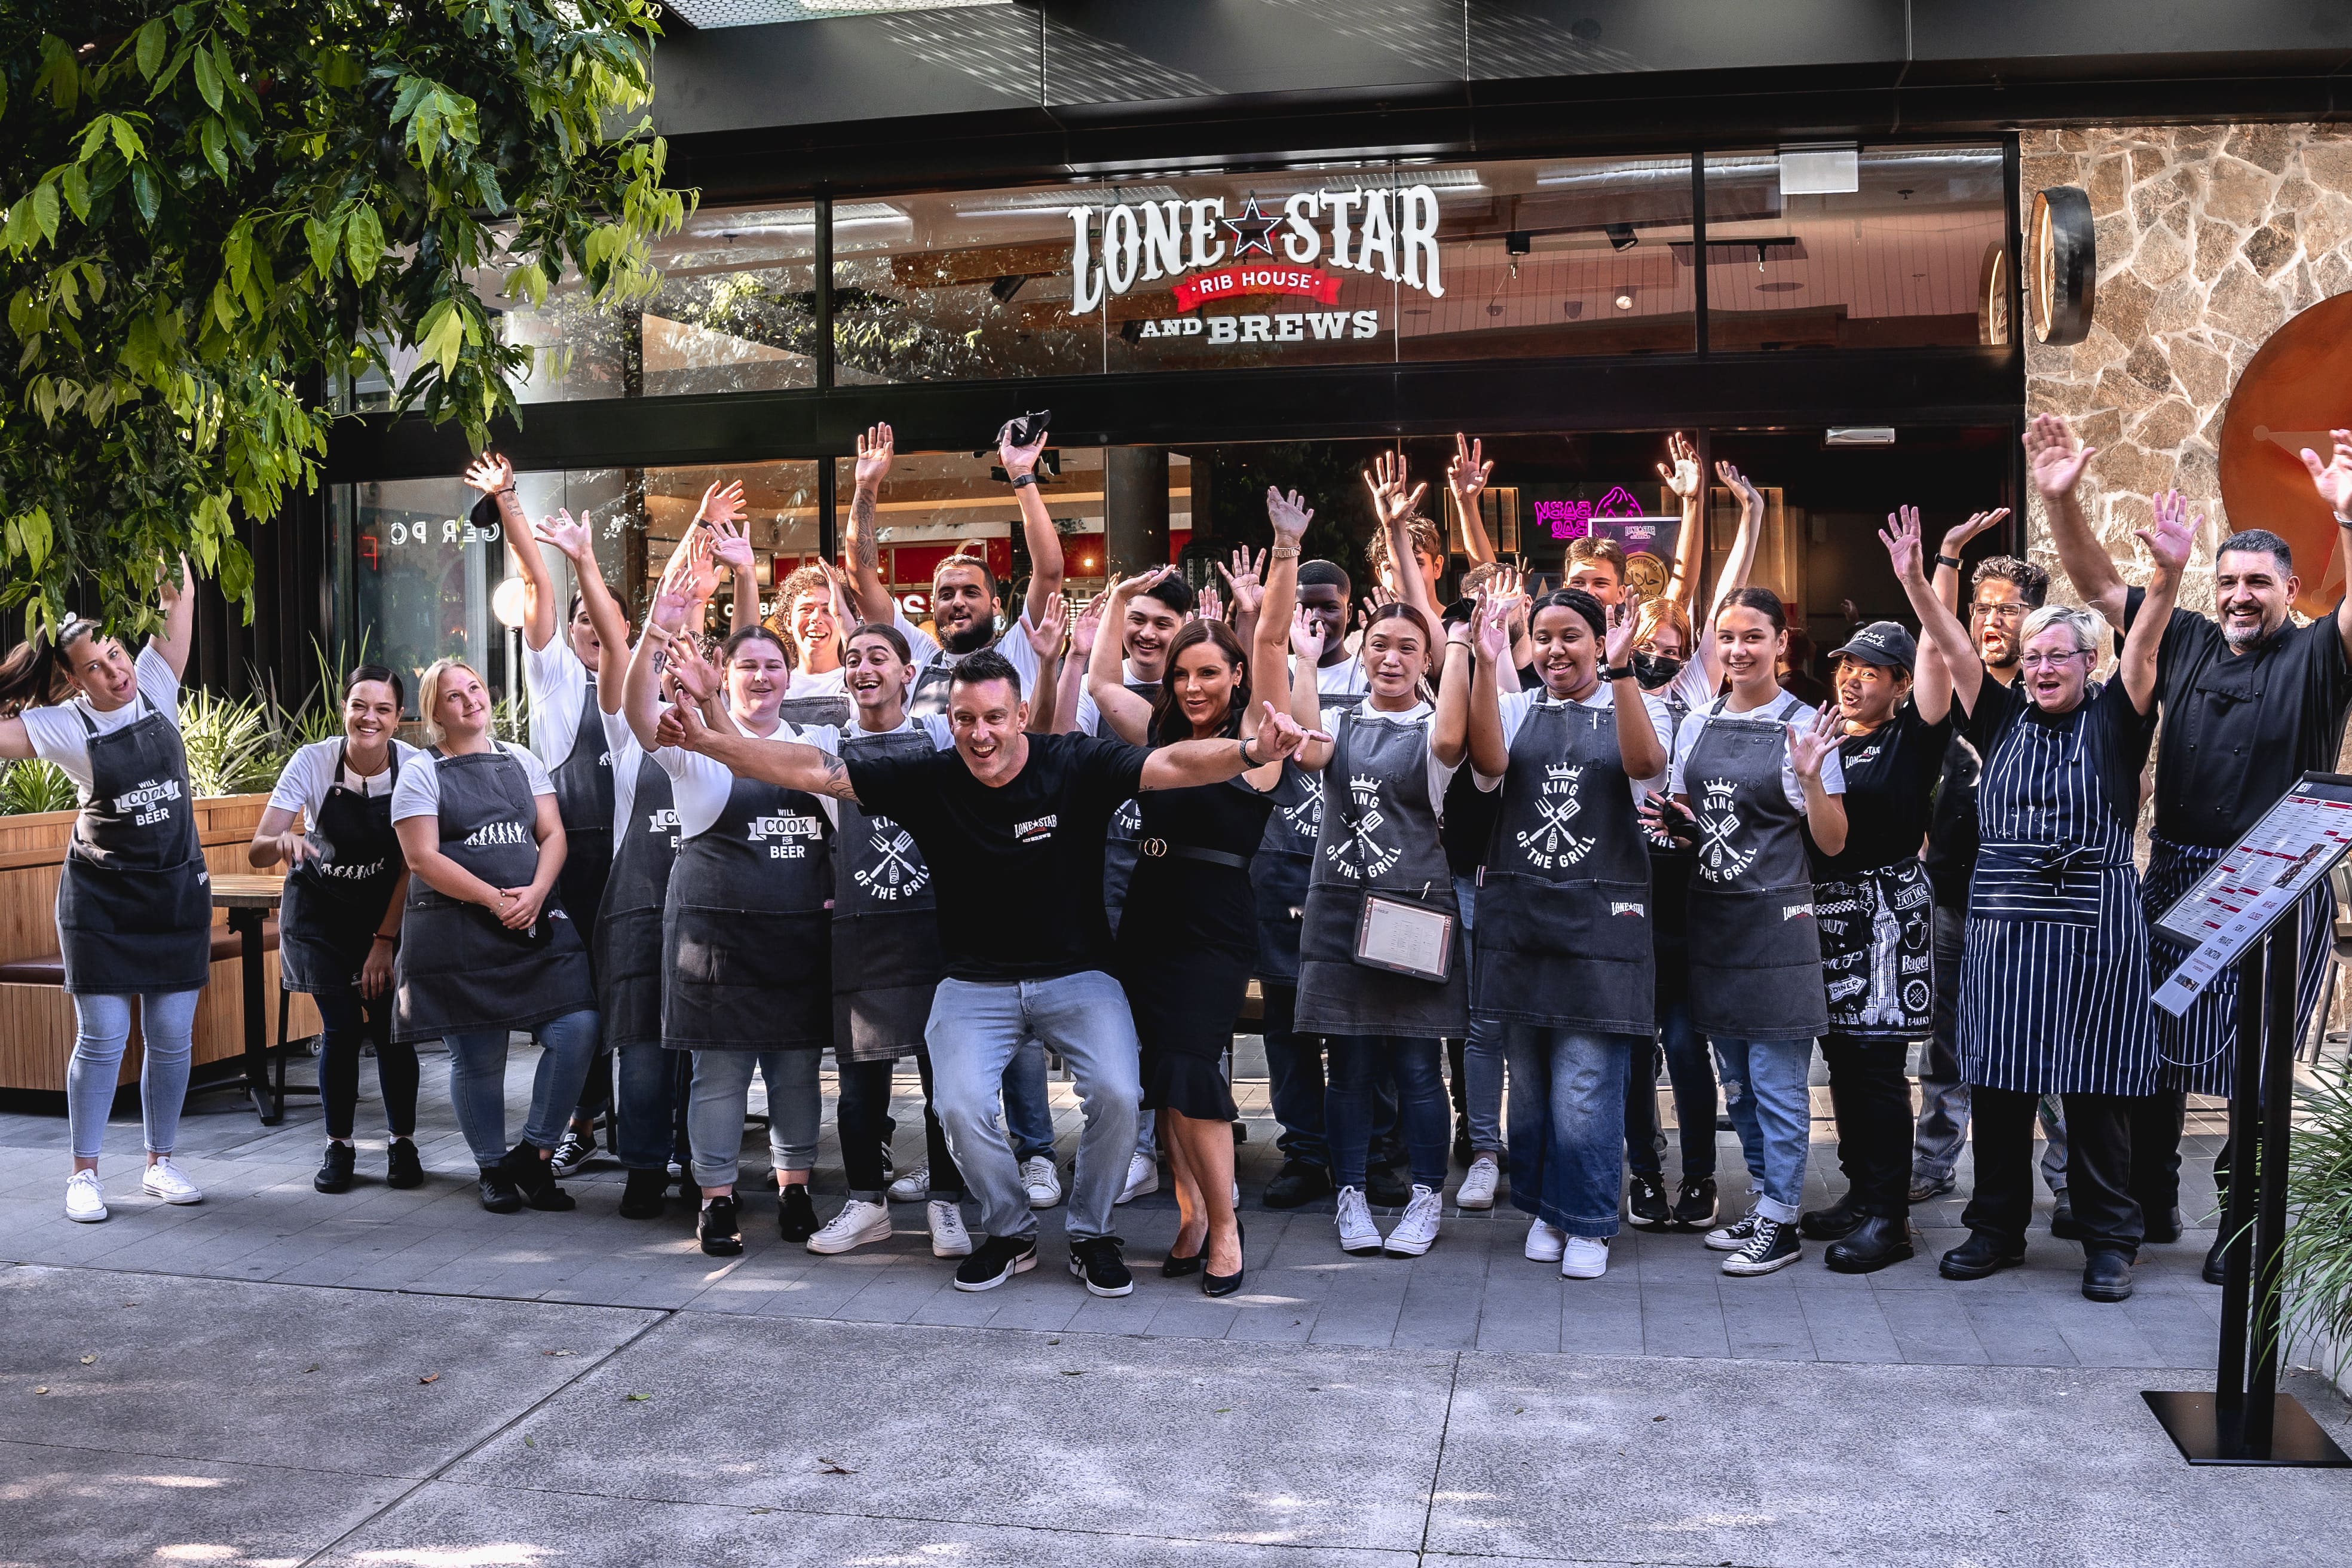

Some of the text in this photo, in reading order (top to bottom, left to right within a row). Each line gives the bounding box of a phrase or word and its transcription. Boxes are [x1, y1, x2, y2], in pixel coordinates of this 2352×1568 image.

[1068, 184, 1445, 316] LONE STAR
[1199, 271, 1311, 295] RIB HOUSE
[1140, 310, 1378, 345] AND BREWS
[138, 779, 158, 789] WILL
[1542, 780, 1579, 797] KING
[128, 786, 167, 804] COOK
[1352, 792, 1380, 808] ING
[1702, 796, 1734, 812] KING
[135, 807, 170, 826] BEER
[764, 819, 809, 832] COOK
[1120, 814, 1141, 830] THE
[1283, 807, 1318, 837] OF THE
[1014, 821, 1034, 838] LONE
[770, 846, 805, 859] BEER
[1517, 831, 1596, 869] OF THE GRILL
[1326, 844, 1339, 861] OF
[1367, 847, 1402, 878] GRILL
[1699, 848, 1757, 883] THE GRILL
[854, 869, 872, 887] OF
[871, 883, 897, 900] THE
[1896, 885, 1928, 907] HOT DOG
[1610, 902, 1629, 916] LONE
[1633, 903, 1644, 918] STAR
[1783, 905, 1801, 921] LONE
[1902, 950, 1929, 973] Bagel
[1833, 980, 1859, 994] DINER
